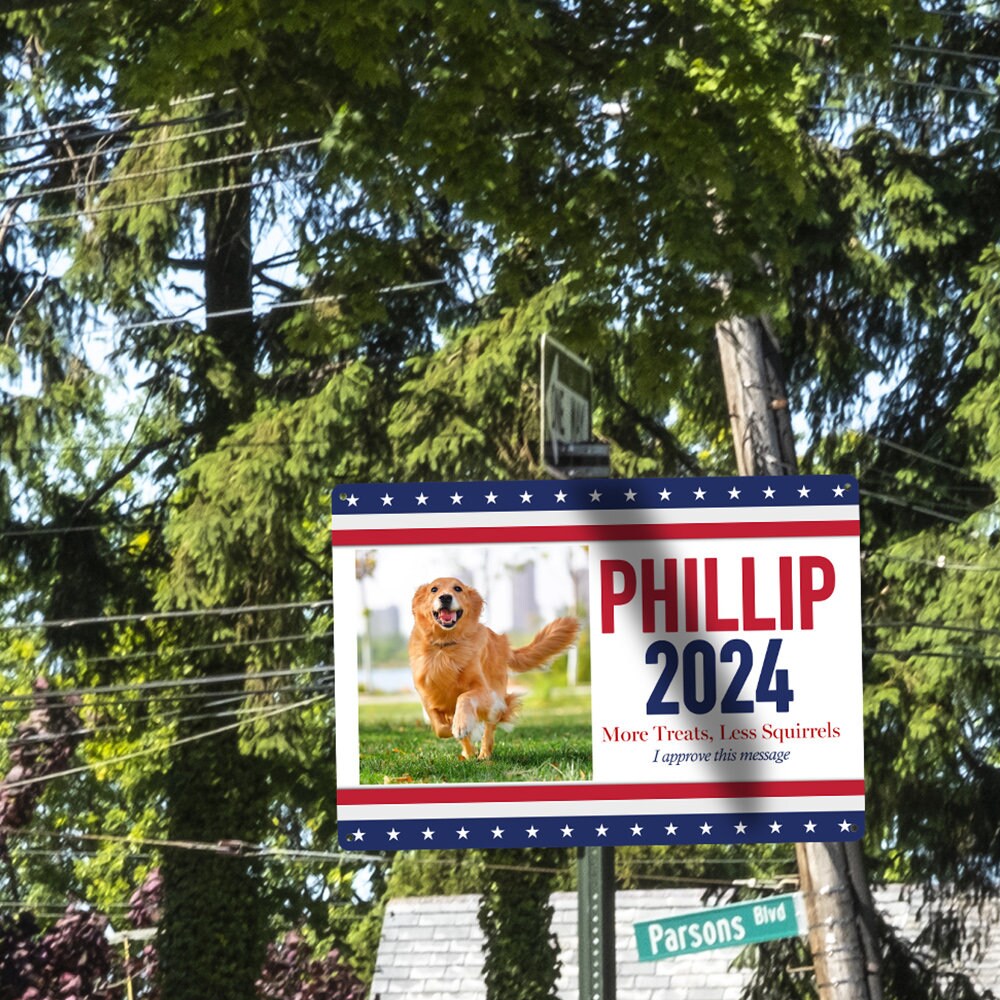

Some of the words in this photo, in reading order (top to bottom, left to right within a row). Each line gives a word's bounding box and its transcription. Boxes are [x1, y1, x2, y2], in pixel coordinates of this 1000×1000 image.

[599, 555, 837, 635] PHILLIP
[644, 637, 795, 716] 2024
[602, 725, 649, 742] More
[652, 725, 714, 742] Treats,
[719, 724, 757, 741] Less
[761, 721, 841, 743] Squirrels
[652, 749, 661, 763] I
[661, 750, 711, 766] approve
[713, 747, 737, 762] this
[739, 749, 791, 767] message
[648, 915, 746, 956] Parsons
[752, 902, 787, 926] Blvd
